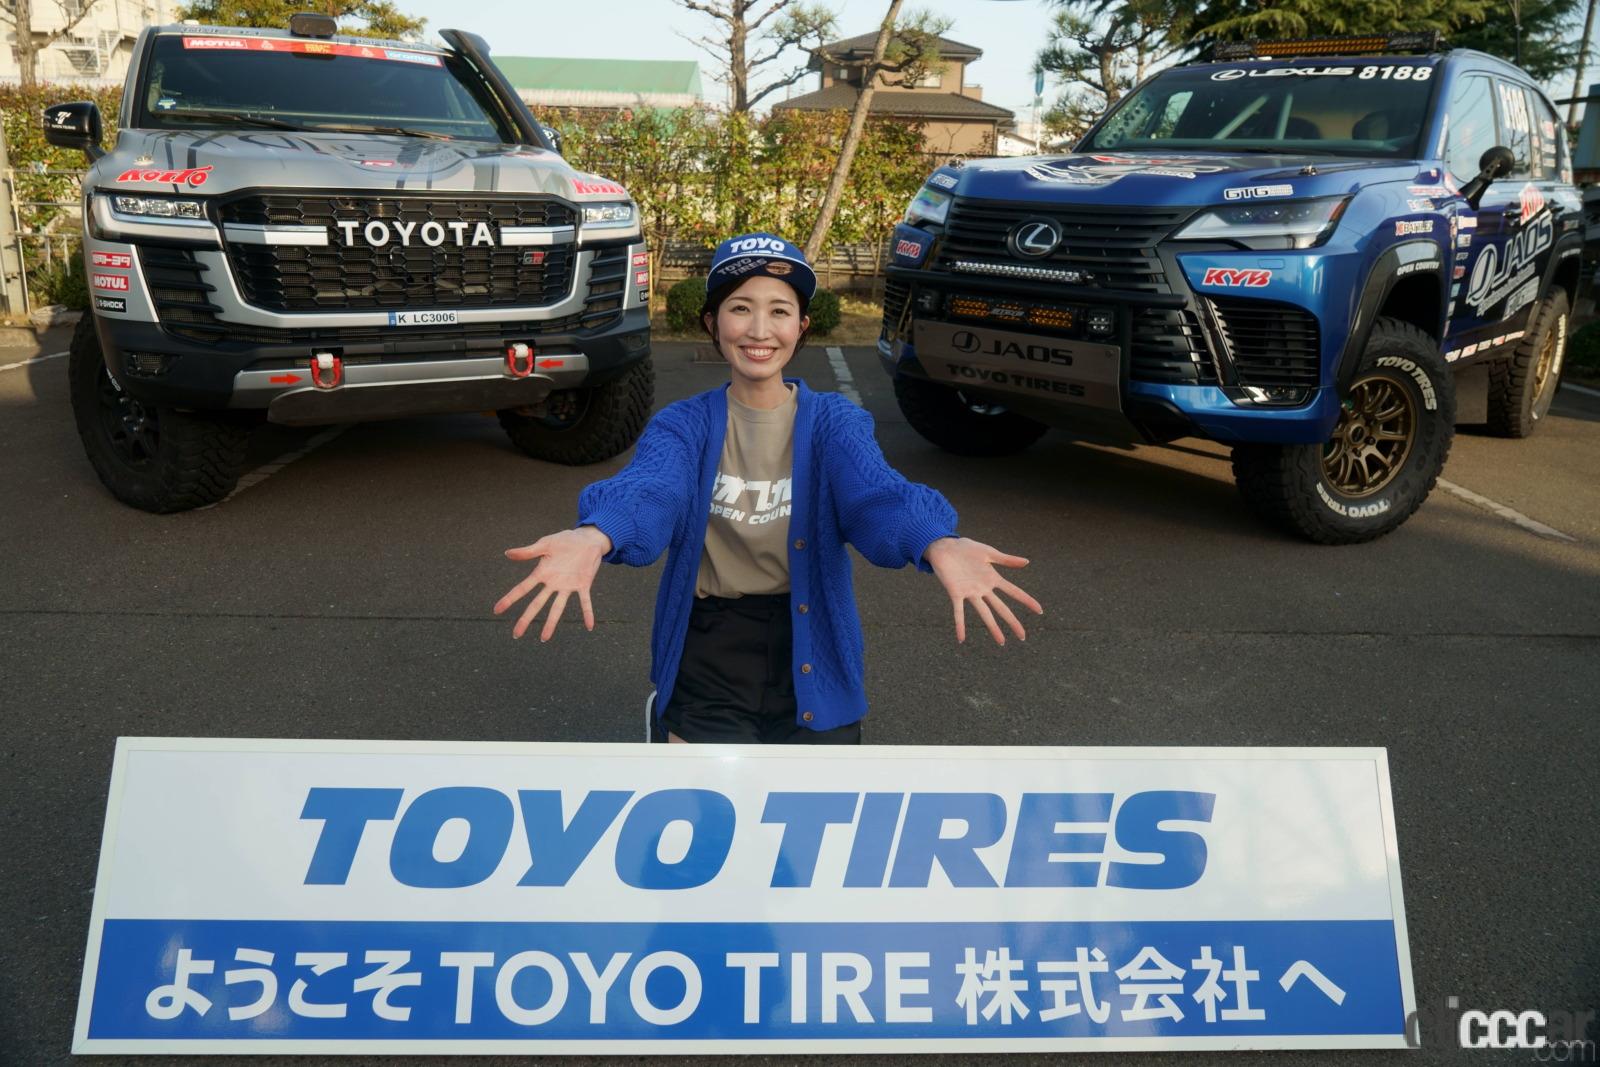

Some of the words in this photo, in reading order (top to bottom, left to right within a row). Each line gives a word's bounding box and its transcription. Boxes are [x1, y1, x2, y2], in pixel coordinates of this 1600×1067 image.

[190, 39, 244, 48] MOTUL
[1249, 67, 1354, 77] LEXUS
[1358, 66, 1433, 81] 8188
[1224, 187, 1269, 200] GTG
[337, 220, 495, 248] TOYOTA
[730, 237, 786, 254] TOYO
[1491, 208, 1554, 288] JAOS
[717, 258, 752, 275] TOYO
[94, 276, 127, 289] MOTUL
[1202, 267, 1272, 287] KYB
[398, 314, 407, 324] K
[413, 313, 455, 324] LC3006
[982, 340, 1073, 366] JAOS
[946, 363, 1008, 384] TOYO
[1010, 374, 1086, 397] TIRES
[1376, 356, 1416, 372] TOYO
[1411, 366, 1438, 410] TIRES
[1348, 498, 1391, 518] TOYO
[299, 786, 736, 890] TOYO
[760, 790, 1217, 890] TIRES
[145, 947, 422, 1021] ようこそ
[439, 949, 702, 1025] TOYO
[726, 952, 933, 1024] TIRE
[955, 946, 1346, 1025] 株式会社へ
